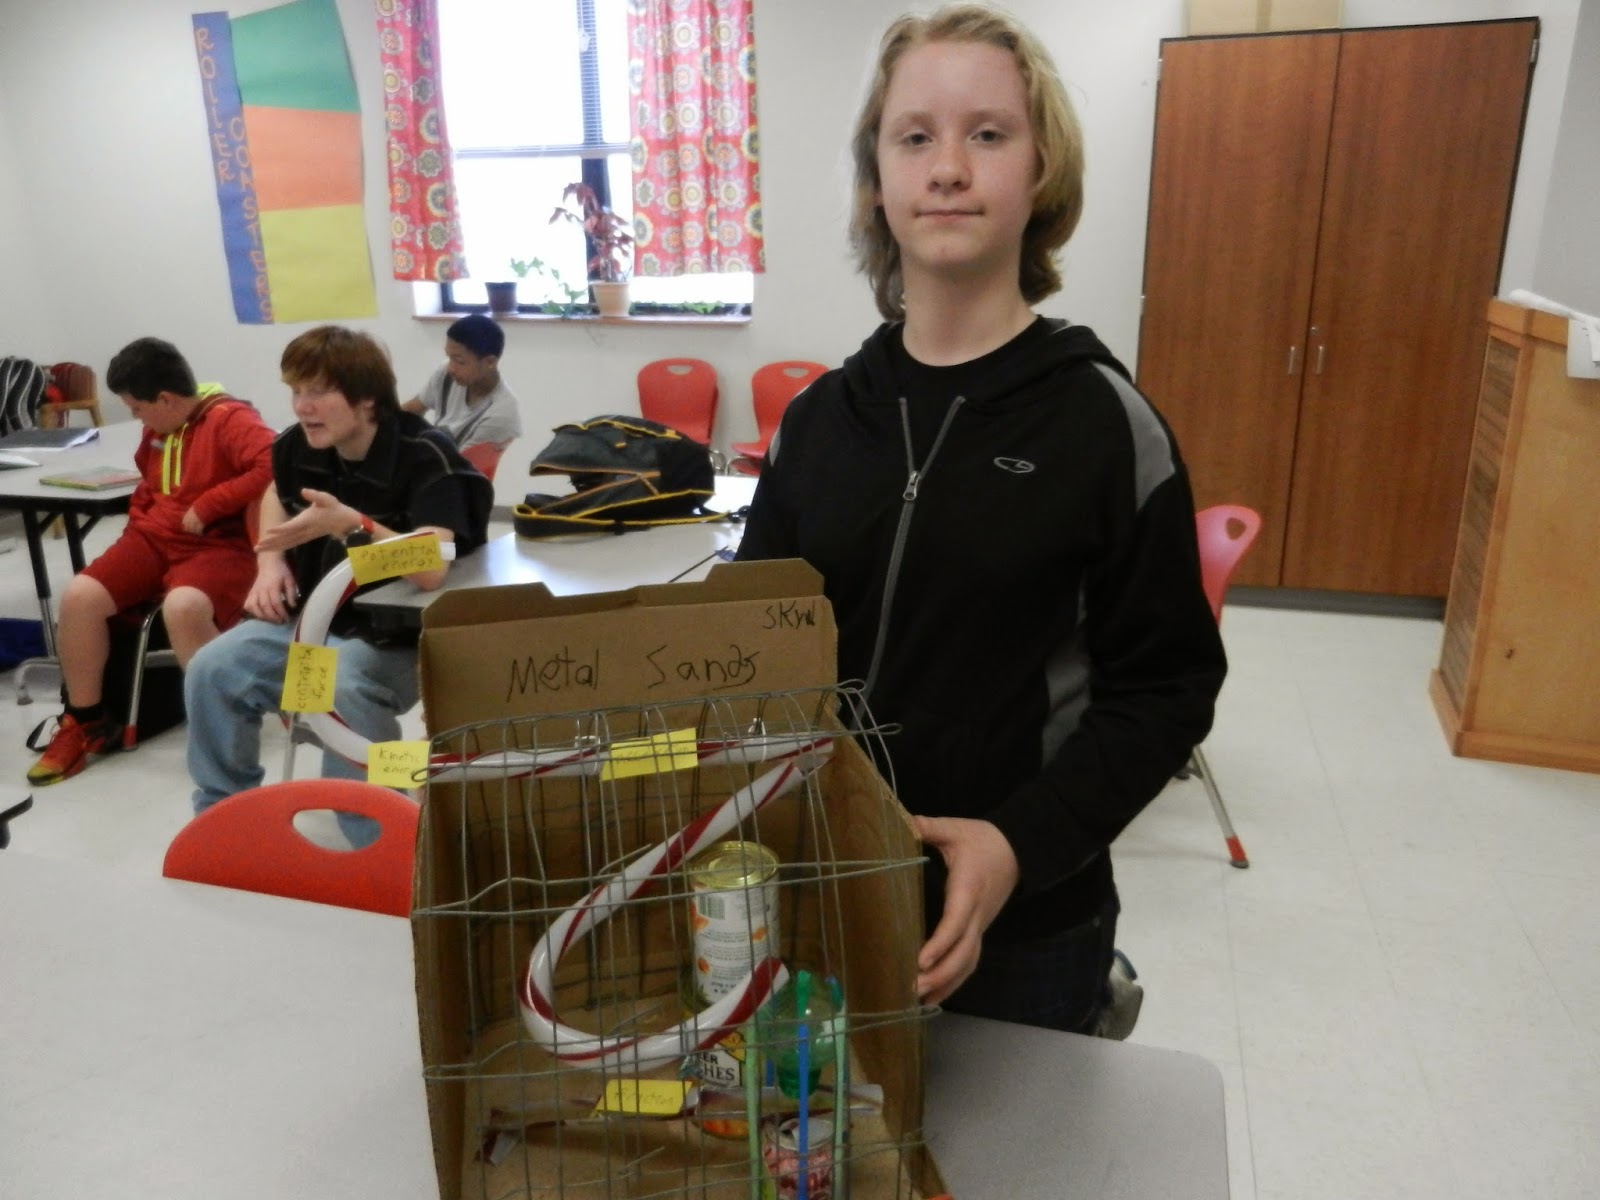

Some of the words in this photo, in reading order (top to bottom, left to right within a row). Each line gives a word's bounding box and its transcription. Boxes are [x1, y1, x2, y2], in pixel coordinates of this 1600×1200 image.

[196, 28, 235, 184] ROLLER
[230, 117, 274, 321] COASTERS
[507, 646, 599, 702] Metal
